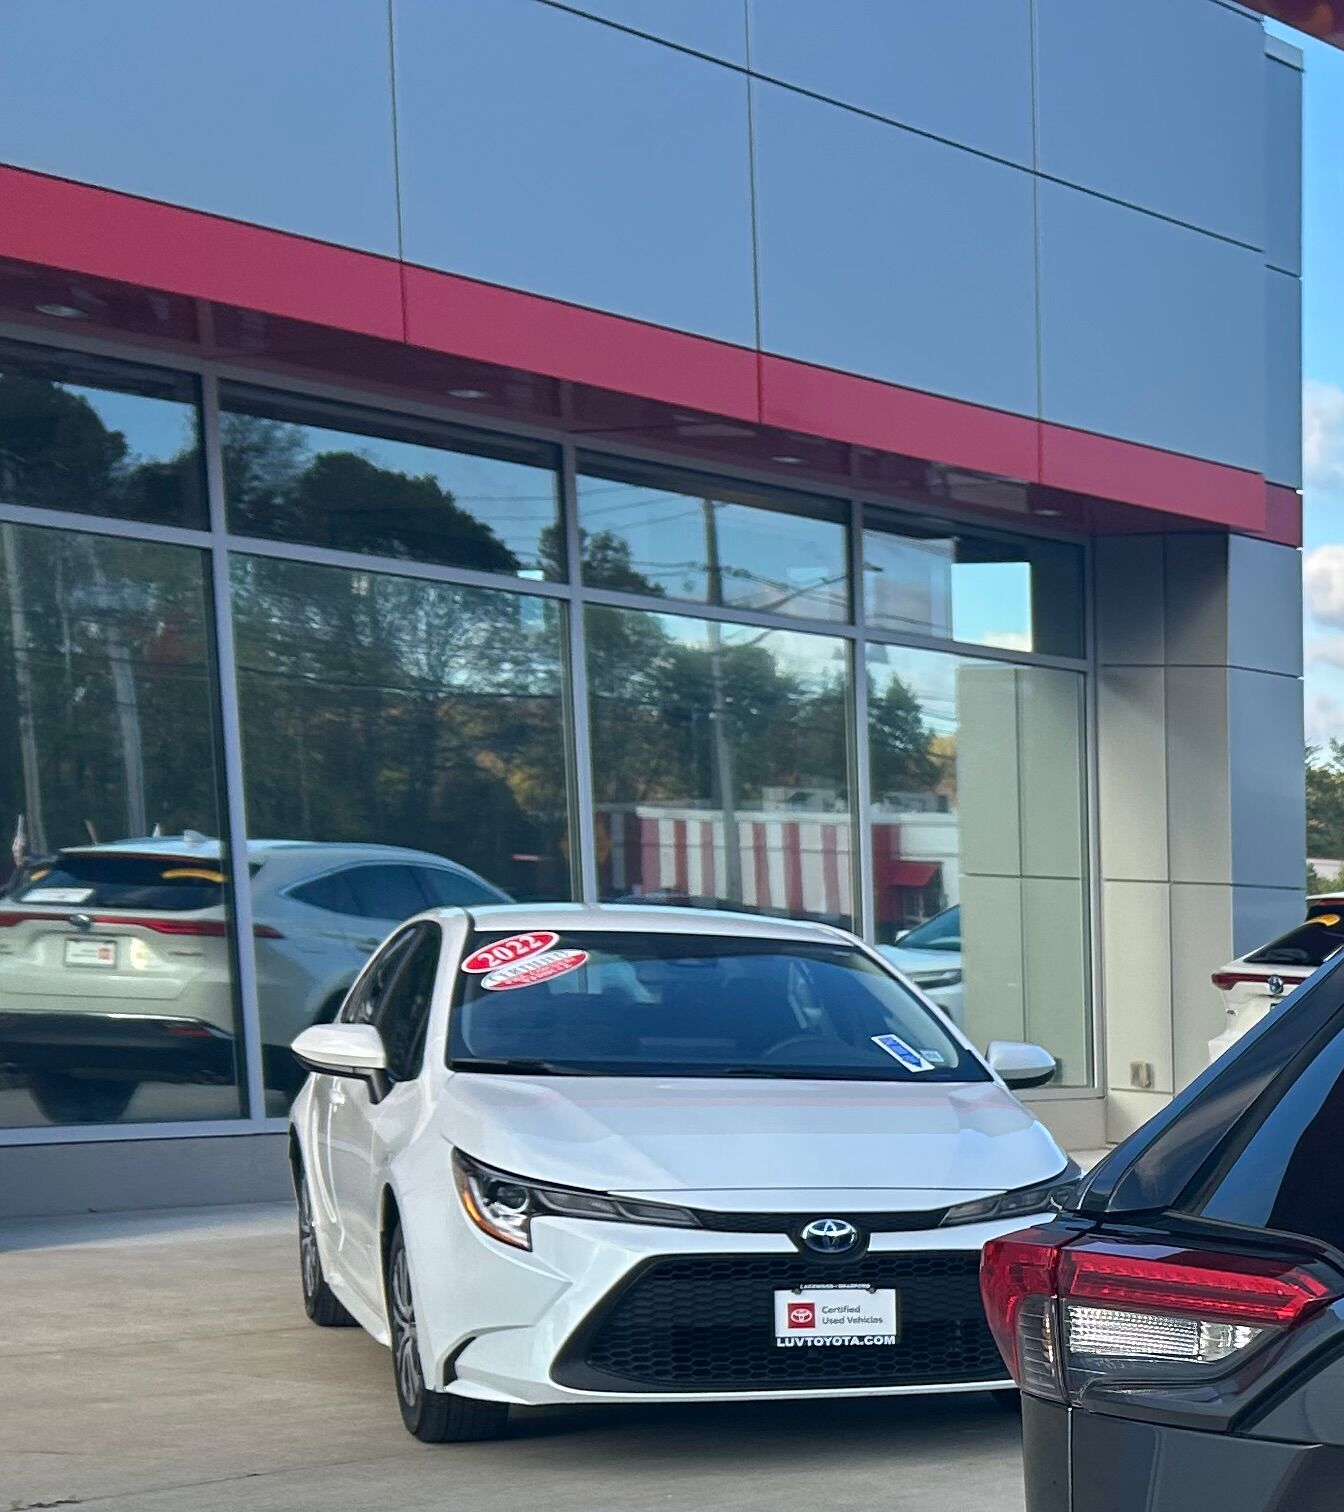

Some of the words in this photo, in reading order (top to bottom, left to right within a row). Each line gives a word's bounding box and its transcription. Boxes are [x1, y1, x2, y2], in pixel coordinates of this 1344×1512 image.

[477, 935, 543, 968] 2022
[821, 1305, 861, 1314] Certified
[822, 1316, 845, 1325] Used
[847, 1316, 883, 1325] Vehicles
[776, 1336, 896, 1347] LUVTOYOTA.COM
